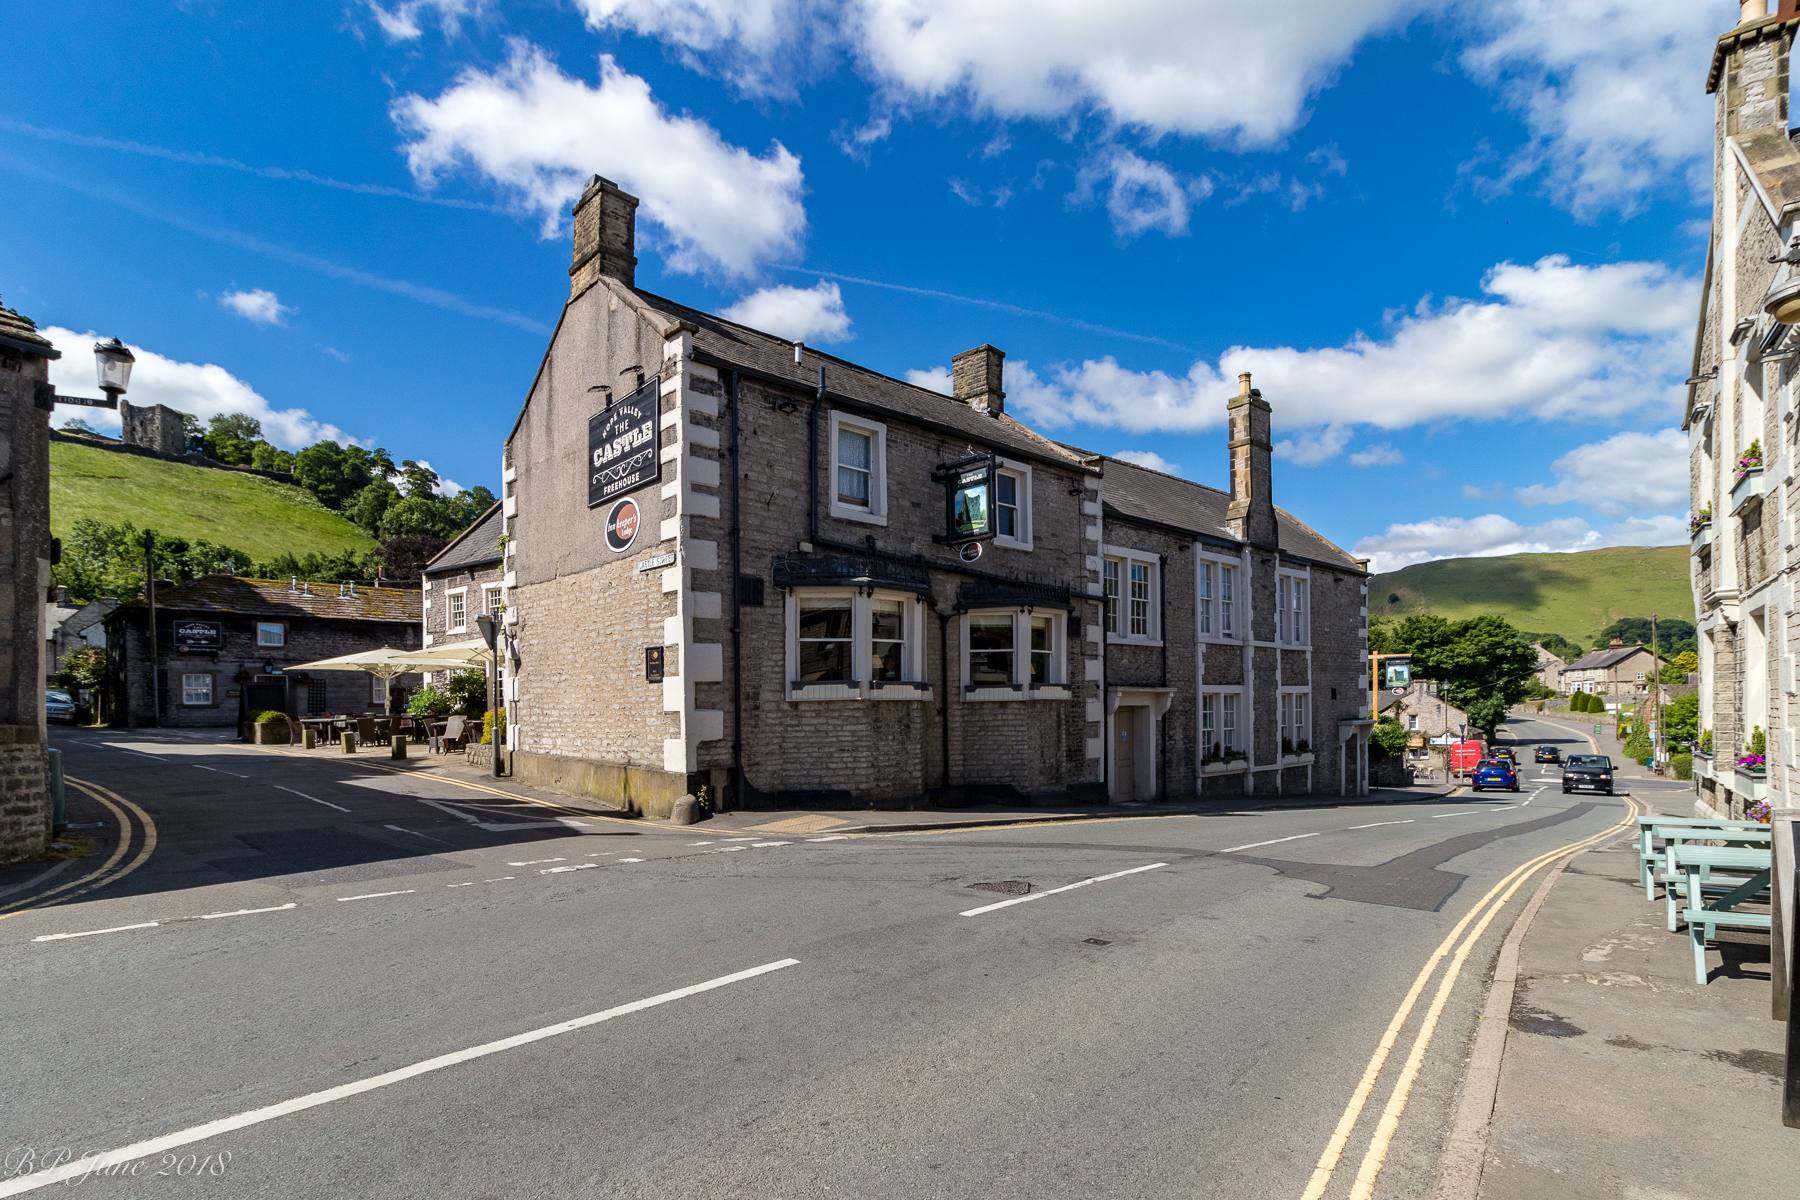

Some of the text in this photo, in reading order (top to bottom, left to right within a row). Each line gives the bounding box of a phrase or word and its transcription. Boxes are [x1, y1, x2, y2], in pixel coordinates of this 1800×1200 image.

[602, 405, 643, 439] HOPE VALLEY
[614, 418, 629, 436] THE
[593, 420, 653, 468] CASTLE
[603, 471, 640, 496] FREEHOUSE
